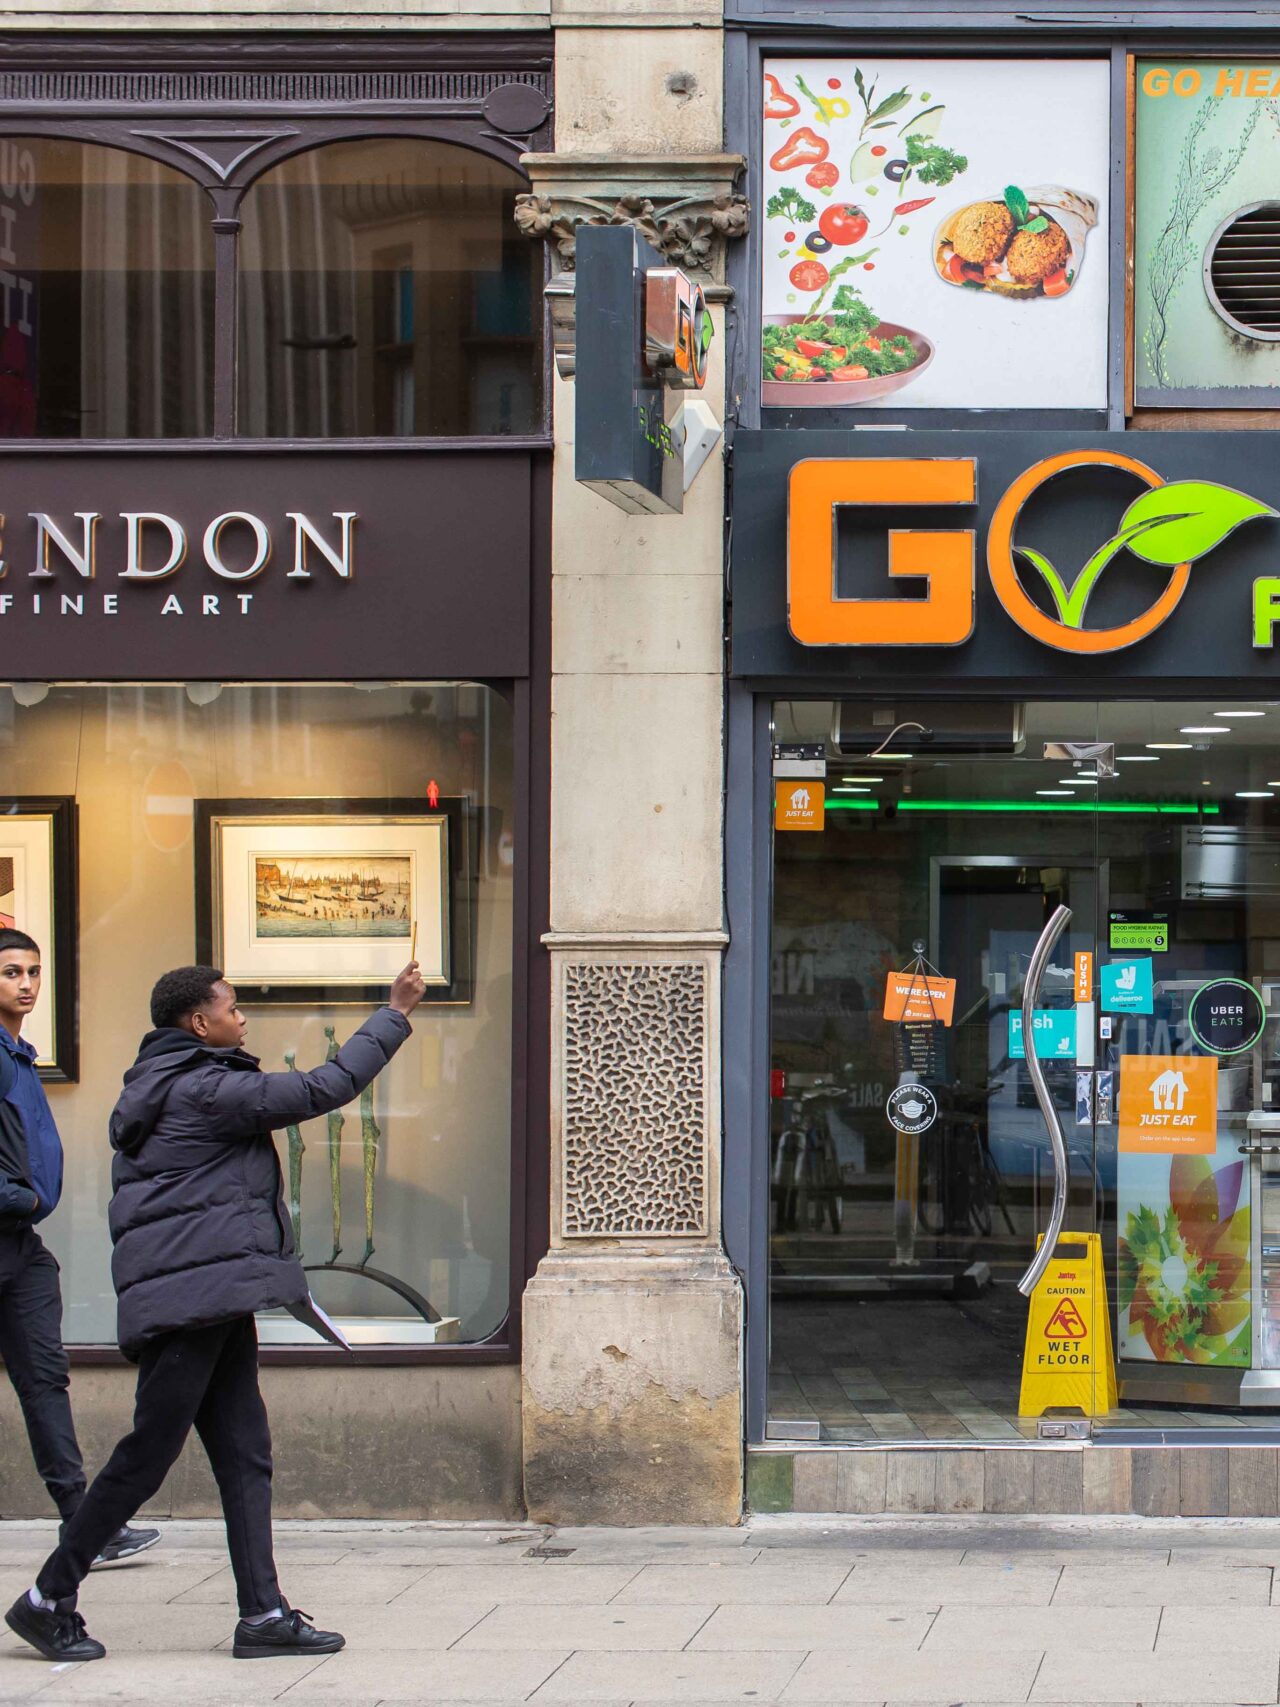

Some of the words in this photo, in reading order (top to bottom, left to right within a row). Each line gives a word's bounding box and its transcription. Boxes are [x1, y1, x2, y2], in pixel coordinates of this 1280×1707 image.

[1142, 68, 1200, 98] GO
[788, 449, 1190, 653] GO
[0, 594, 118, 615] FINE
[160, 594, 253, 615] ART
[1080, 956, 1088, 987] PUSH
[896, 986, 922, 997] WERE
[1110, 995, 1143, 1003] deliveroo
[1210, 1006, 1243, 1015] UBER
[1012, 1014, 1053, 1033] psh
[1212, 1018, 1243, 1027] EATS
[891, 1087, 912, 1104] PLEASE
[913, 1087, 930, 1100] WEAR
[892, 1116, 905, 1129] FACE
[905, 1116, 932, 1131] COVERING
[1139, 1114, 1170, 1127] JUST
[1172, 1115, 1198, 1126] EAT
[1047, 1287, 1086, 1295] CAUTION
[1048, 1342, 1081, 1352] WET
[1038, 1354, 1090, 1365] FLOOR
